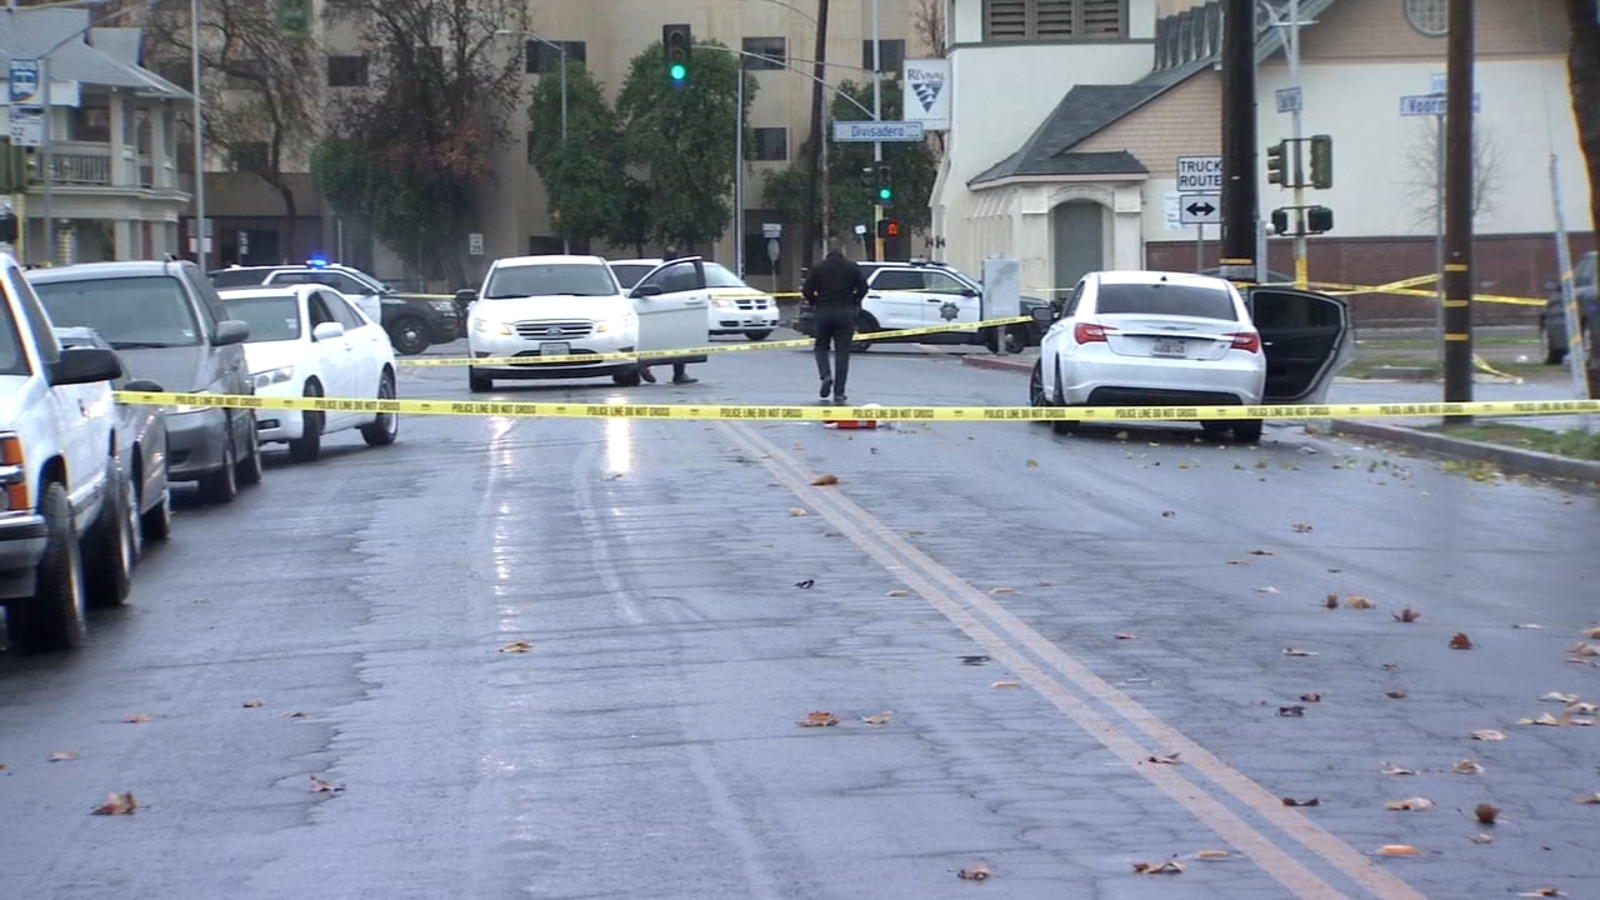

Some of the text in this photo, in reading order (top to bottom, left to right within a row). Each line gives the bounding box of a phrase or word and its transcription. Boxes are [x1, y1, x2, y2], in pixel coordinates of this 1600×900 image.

[851, 125, 905, 138] Divisadero
[1181, 160, 1222, 172] TRUCK
[1180, 175, 1221, 187] ROUTE
[175, 395, 197, 405] POLICE
[199, 395, 213, 405] LINE
[215, 397, 223, 406] DO
[226, 397, 238, 406] NOT
[315, 400, 400, 411] POLICE LINE DO NOT CROSS
[453, 403, 536, 414] POLICE LINE DO NOT CROSS
[587, 406, 670, 416] POLICE LINE DO NOT CROSS
[720, 408, 802, 418] POLICE LINE DO NOT CROSS
[853, 409, 933, 418] POLICE LINE DO NOT CROSS
[984, 409, 1004, 418] POLICE
[1006, 409, 1019, 418] LINE
[1021, 409, 1030, 418] DO
[1031, 409, 1043, 418] NOT
[1115, 409, 1136, 418] POLICE
[1138, 409, 1151, 418] LINE
[1153, 408, 1161, 418] DO
[1163, 408, 1175, 418] NOT
